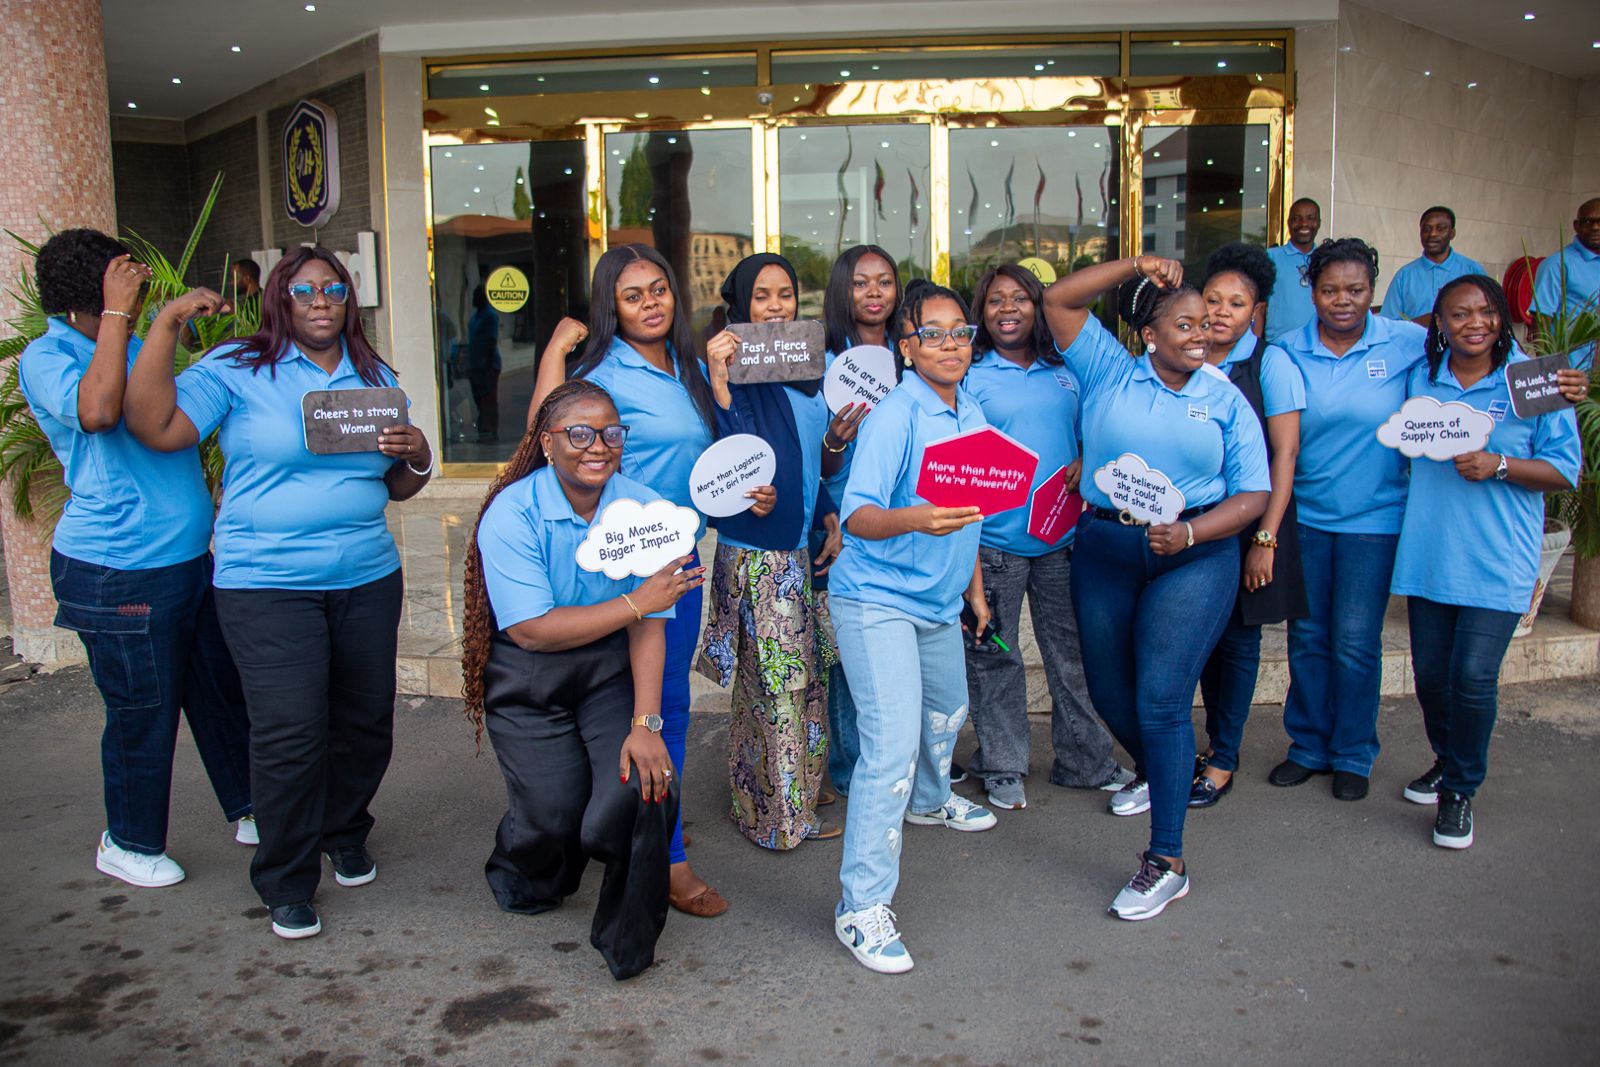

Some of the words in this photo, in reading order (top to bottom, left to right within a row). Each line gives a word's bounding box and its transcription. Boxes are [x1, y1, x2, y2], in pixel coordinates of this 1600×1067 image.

[491, 291, 524, 299] CAUTION
[742, 342, 769, 353] Fast,
[774, 340, 807, 351] Fierce
[741, 354, 760, 365] and
[763, 355, 776, 364] on
[779, 351, 810, 362] Track
[843, 356, 859, 373] You
[860, 371, 876, 385] are
[838, 374, 856, 389] own
[1515, 379, 1526, 389] She
[313, 408, 349, 420] Cheers
[352, 407, 364, 418] to
[367, 407, 399, 419] strong
[339, 423, 376, 434] Women
[1404, 420, 1445, 431] Queens
[1449, 417, 1461, 428] of
[1400, 430, 1435, 443] Supply
[1439, 429, 1470, 439] Chain
[927, 461, 956, 473] More
[960, 464, 985, 476] than
[988, 466, 1027, 482] Pretty,
[697, 480, 715, 494] More
[717, 469, 733, 482] than
[710, 487, 725, 498] It's
[726, 477, 740, 490] Girl
[740, 466, 761, 481] Power
[934, 473, 966, 485] We're
[970, 479, 1018, 491] Powerful
[1111, 468, 1128, 481] She
[1131, 474, 1166, 494] believed
[1117, 481, 1131, 493] she
[1113, 491, 1129, 502] and
[1131, 497, 1146, 509] she
[1148, 503, 1162, 515] did
[605, 531, 624, 545] Big
[629, 522, 668, 539] Moves,
[599, 543, 636, 561] Bigger
[640, 530, 681, 550] Impact
